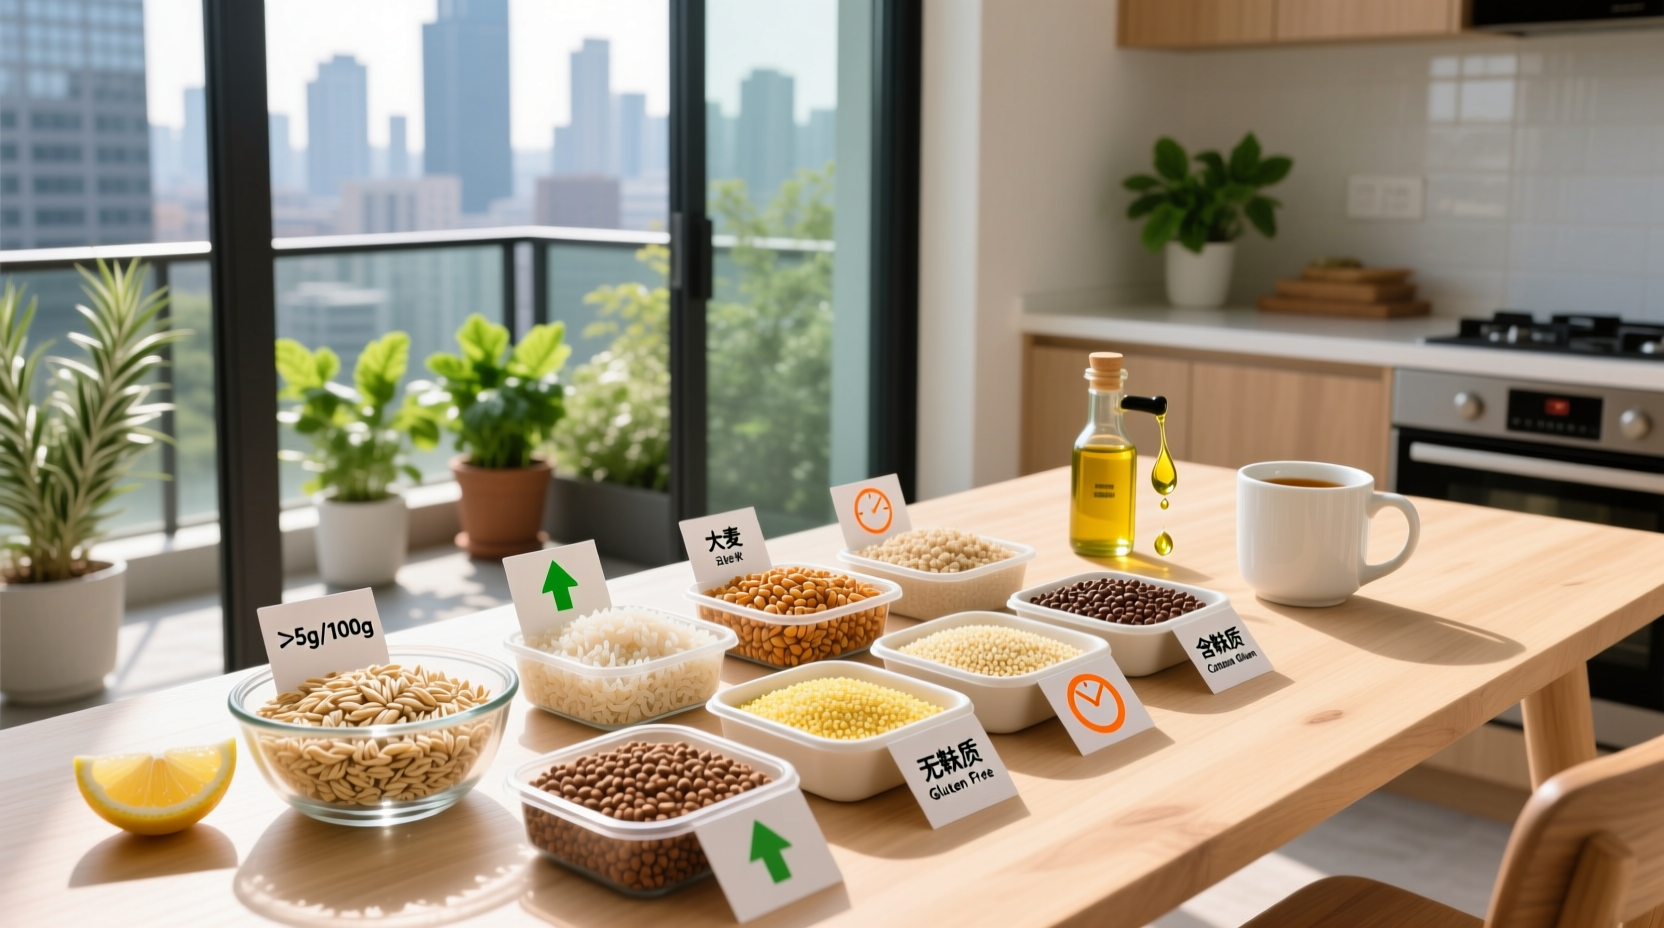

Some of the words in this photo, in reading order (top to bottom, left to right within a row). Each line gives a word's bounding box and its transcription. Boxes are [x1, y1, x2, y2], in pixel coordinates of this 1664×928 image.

[704, 525, 744, 553] 大麦
[277, 617, 375, 649] >5g/100g
[928, 779, 969, 801] Gluten
